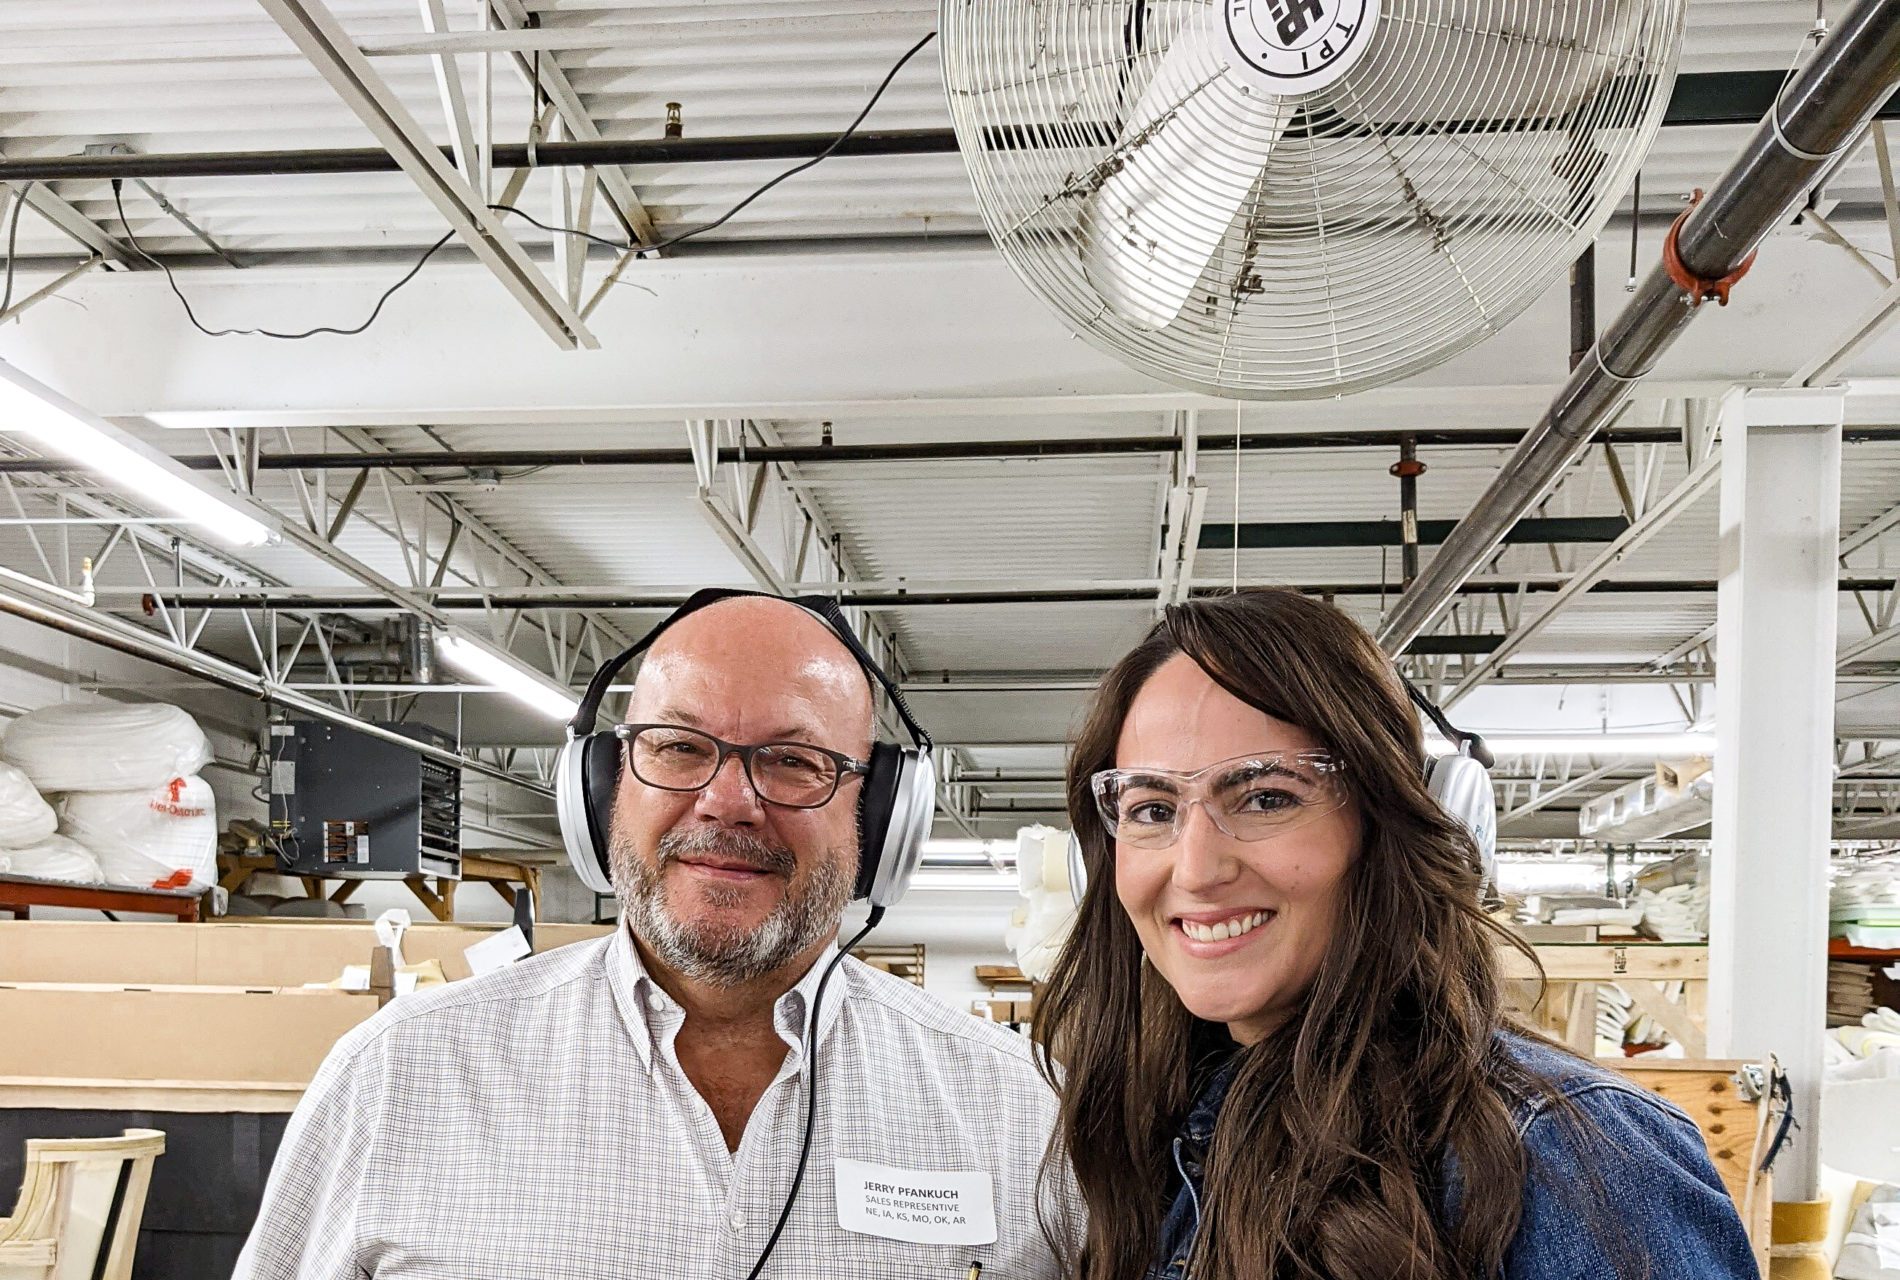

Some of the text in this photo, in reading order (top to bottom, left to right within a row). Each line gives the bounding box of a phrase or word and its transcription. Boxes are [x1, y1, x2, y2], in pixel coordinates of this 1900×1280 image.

[1301, 21, 1354, 71] TPI
[864, 1181, 959, 1199] JERRY PFANKUCH
[865, 1194, 960, 1212] SALES REPRESENTIVE
[865, 1206, 966, 1225] NE, IA, KS, MO, OK, AR
